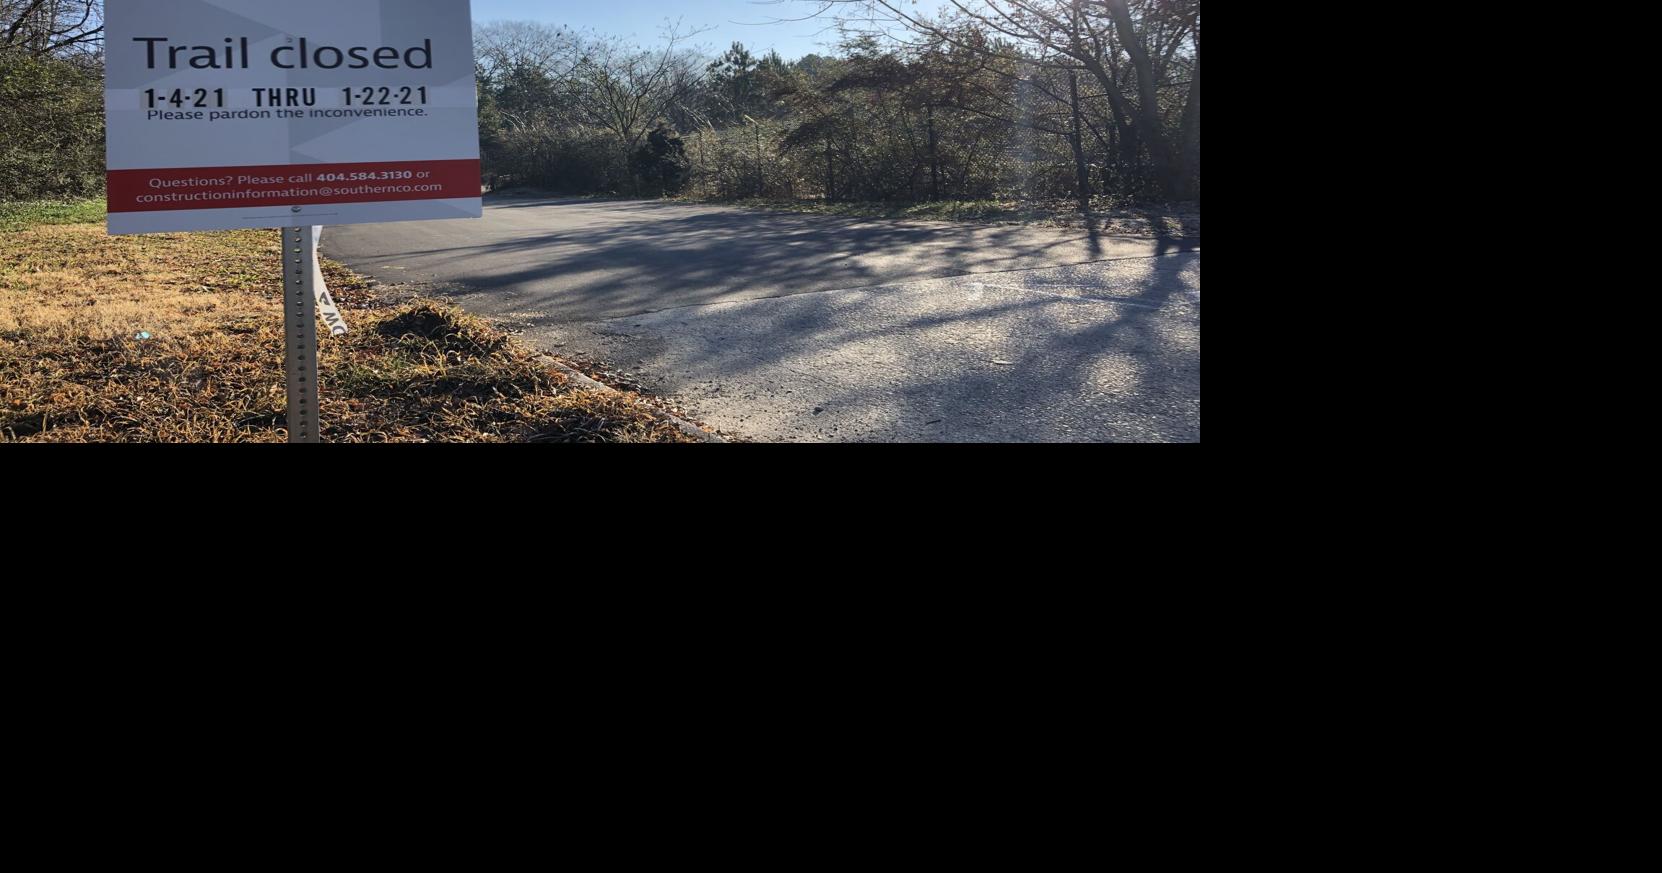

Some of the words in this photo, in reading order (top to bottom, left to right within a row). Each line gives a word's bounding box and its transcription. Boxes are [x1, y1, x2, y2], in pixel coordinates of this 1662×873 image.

[132, 36, 249, 69] Trail
[269, 36, 433, 70] closed
[251, 87, 316, 107] THRU
[147, 109, 204, 121] Please
[209, 109, 271, 122] pardon
[275, 108, 304, 118] the
[309, 107, 428, 118] inconvenience.
[149, 175, 233, 189] Questions?
[237, 175, 285, 185] Please
[288, 173, 313, 183] call
[316, 170, 412, 182] 404.584.3130
[416, 170, 430, 179] or
[135, 182, 442, 203] constructioninformation@southernco.com
